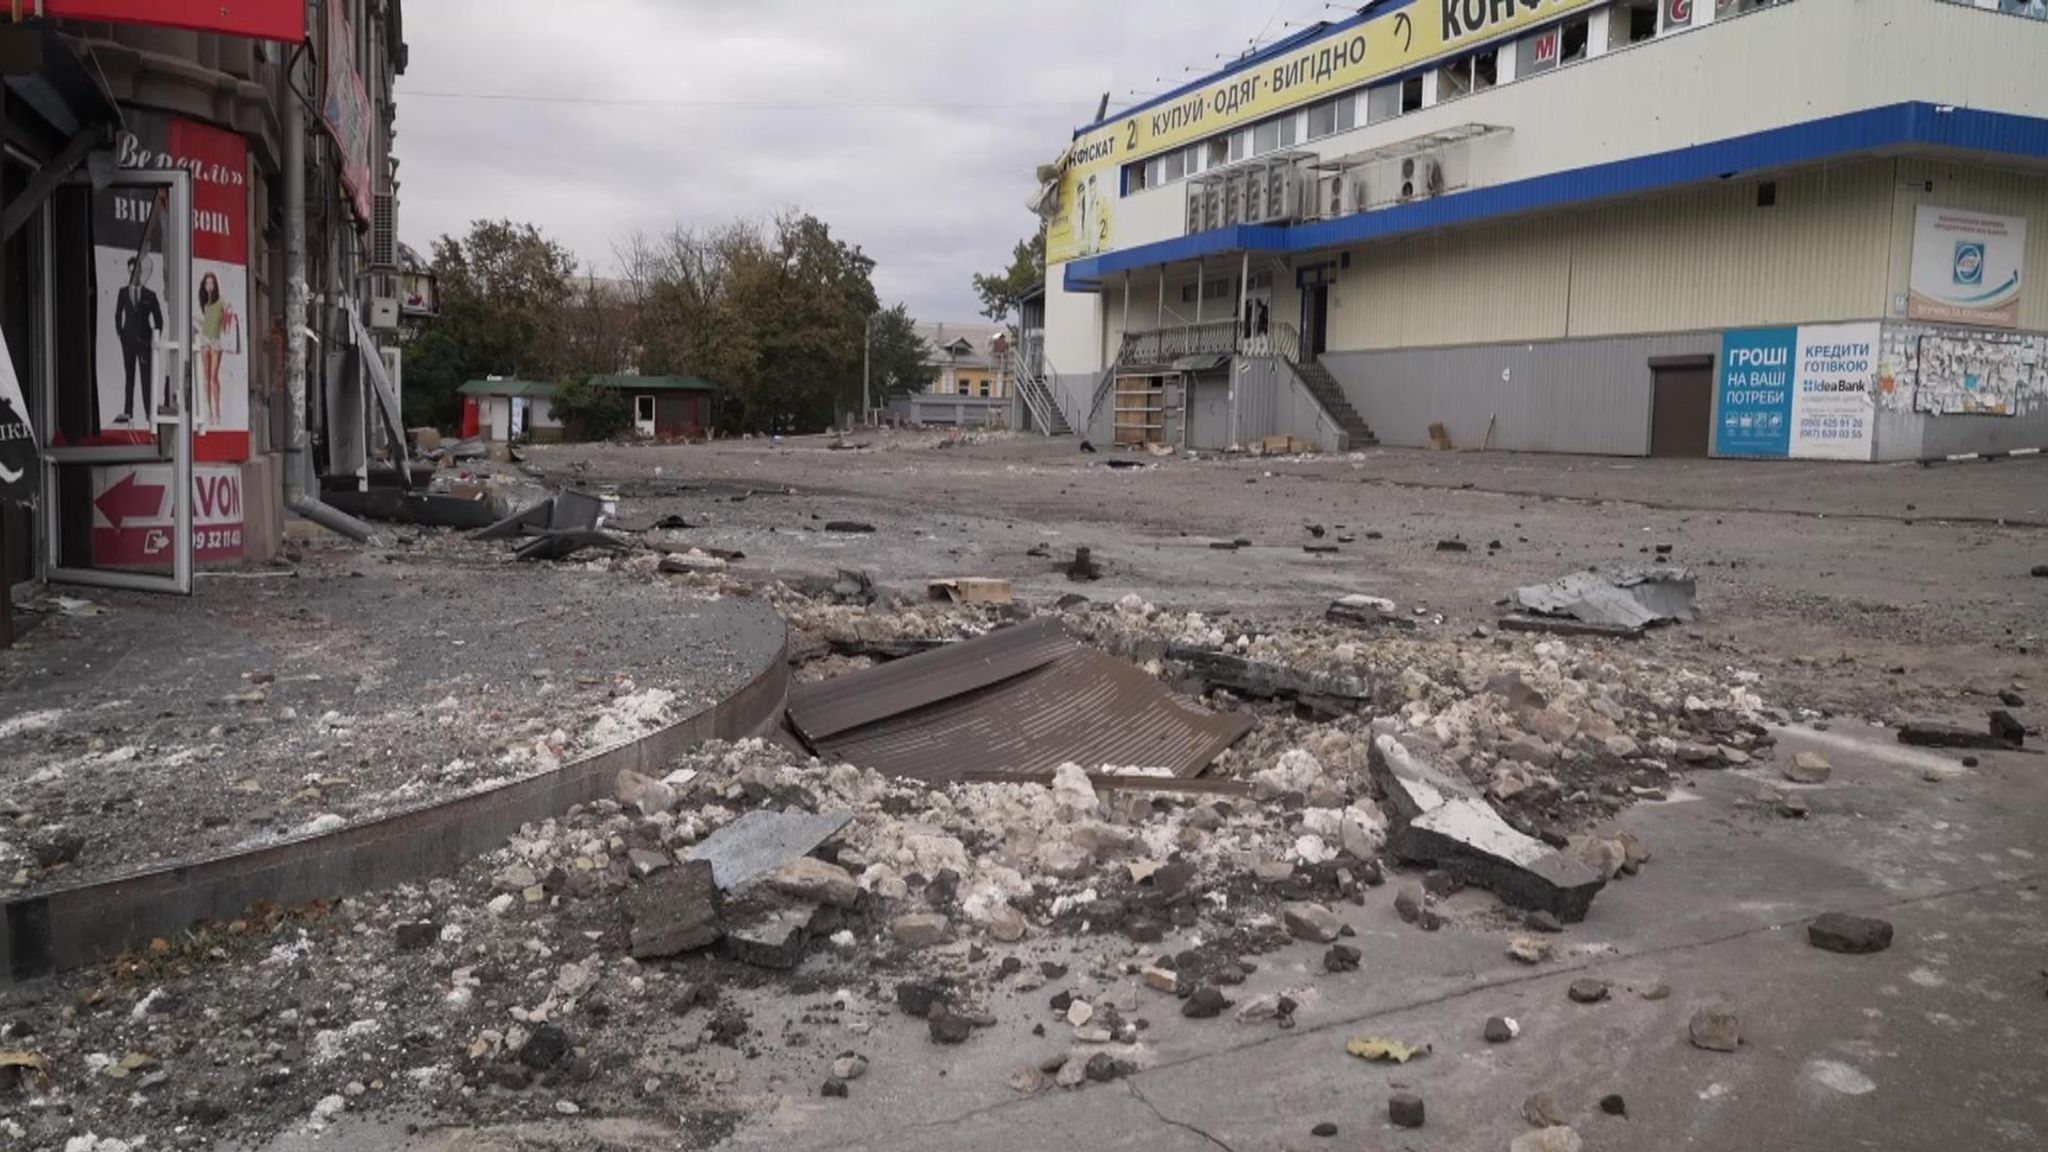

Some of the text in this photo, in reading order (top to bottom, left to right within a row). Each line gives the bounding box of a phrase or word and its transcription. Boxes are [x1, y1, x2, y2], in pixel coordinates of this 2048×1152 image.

[1153, 35, 1366, 136] КУПУЙ ОДЯГ ВИГІДНО
[1060, 119, 1138, 175] НФІСКАТ 2
[1729, 347, 1787, 366] ГРОШІ
[1805, 344, 1869, 360] КРЕДИТИ
[1804, 360, 1868, 373] ГОТІВКОЮ
[1728, 372, 1785, 387] НА ВАШІ
[1727, 390, 1784, 404] ПОТРЕБИ
[170, 476, 241, 518] VON
